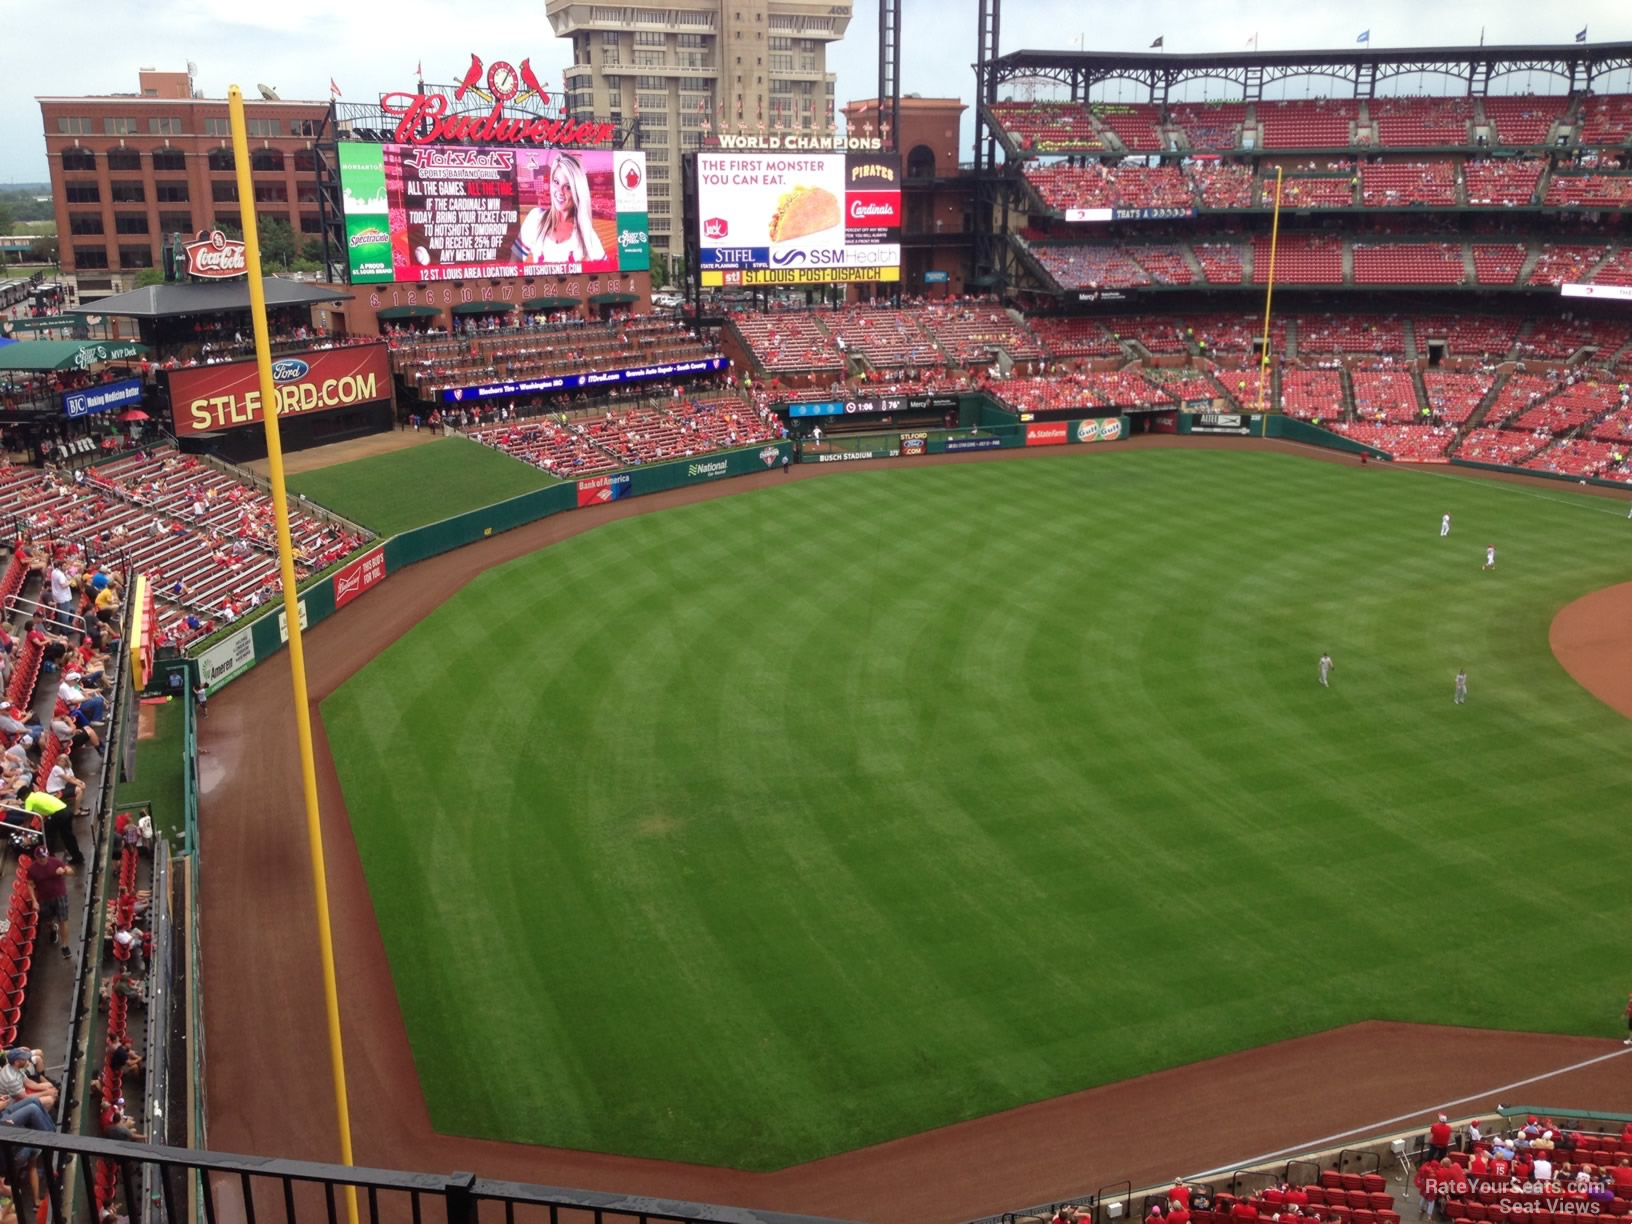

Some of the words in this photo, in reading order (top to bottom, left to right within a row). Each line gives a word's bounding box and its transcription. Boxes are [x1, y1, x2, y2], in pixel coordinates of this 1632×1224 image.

[380, 92, 616, 145] Budweiser
[717, 134, 780, 149] WORLD
[784, 135, 881, 149] CHAMPIONS
[702, 160, 726, 171] THE
[730, 160, 762, 171] FIRST
[766, 160, 824, 171] MONSTER
[852, 164, 894, 181] PIRATES
[419, 169, 447, 178] SPORTS
[448, 169, 463, 178] BAR
[465, 169, 479, 178] AND
[480, 170, 500, 179] GRILL
[702, 174, 729, 185] YOU
[732, 174, 758, 185] CAN
[762, 174, 786, 185] EAT.
[407, 181, 422, 195] ALL
[422, 181, 437, 195] THE
[438, 181, 466, 196] GAMES.
[426, 198, 433, 210] IF
[434, 198, 448, 210] THE
[448, 198, 486, 210] CARDINALS
[487, 198, 501, 210] WIN
[851, 200, 894, 218] Cardinals
[409, 211, 434, 224] TODAY,
[436, 211, 457, 223] BRING
[458, 211, 476, 223] YOUR
[477, 211, 500, 223] TICKET
[500, 210, 517, 223] STUB
[424, 224, 433, 236] TO
[434, 224, 469, 236] HOTSHOTS
[471, 224, 508, 236] TOMORROW
[350, 232, 389, 247] Spectracide
[429, 237, 444, 249] AND
[445, 236, 473, 249] RECEIVE
[474, 236, 490, 248] 25%
[490, 236, 503, 247] OFF
[440, 249, 455, 262] ANY
[456, 249, 475, 261] MENU
[715, 248, 756, 263] STIFEL
[420, 269, 429, 280] 12
[430, 269, 442, 280] ST.
[443, 268, 462, 279] LOUIS
[463, 267, 481, 278] AREA
[482, 266, 518, 278] LOCATIONS
[745, 270, 761, 283] ST.
[763, 269, 795, 282] LOUIS
[800, 267, 880, 281] POST-DISPATCH
[502, 285, 513, 300] 17
[522, 285, 536, 299] 20
[544, 284, 558, 297] 24
[566, 282, 580, 296] 42
[587, 281, 600, 294] 45
[607, 280, 620, 293] 85
[393, 291, 399, 306] 1
[407, 291, 417, 305] 2
[426, 289, 434, 304] 6
[443, 289, 452, 303] 9
[461, 287, 473, 303] 10
[481, 287, 493, 301] 14
[1079, 293, 1095, 301] Mercy
[111, 349, 123, 359] MVP
[124, 346, 137, 357] Deck
[273, 363, 301, 380] Ford
[520, 382, 552, 391] Washington
[69, 397, 85, 415] BJC
[1079, 425, 1097, 437] Gulf
[1100, 423, 1119, 435] Gulf
[843, 451, 872, 460] STADIUM
[697, 459, 728, 474] National
[579, 480, 596, 490] Bank
[596, 478, 603, 487] of
[603, 475, 630, 485] America
[362, 560, 372, 573] THIS
[363, 572, 372, 584] FOR
[211, 658, 232, 680] Ameren
[1496, 1166, 1505, 1175] 15
